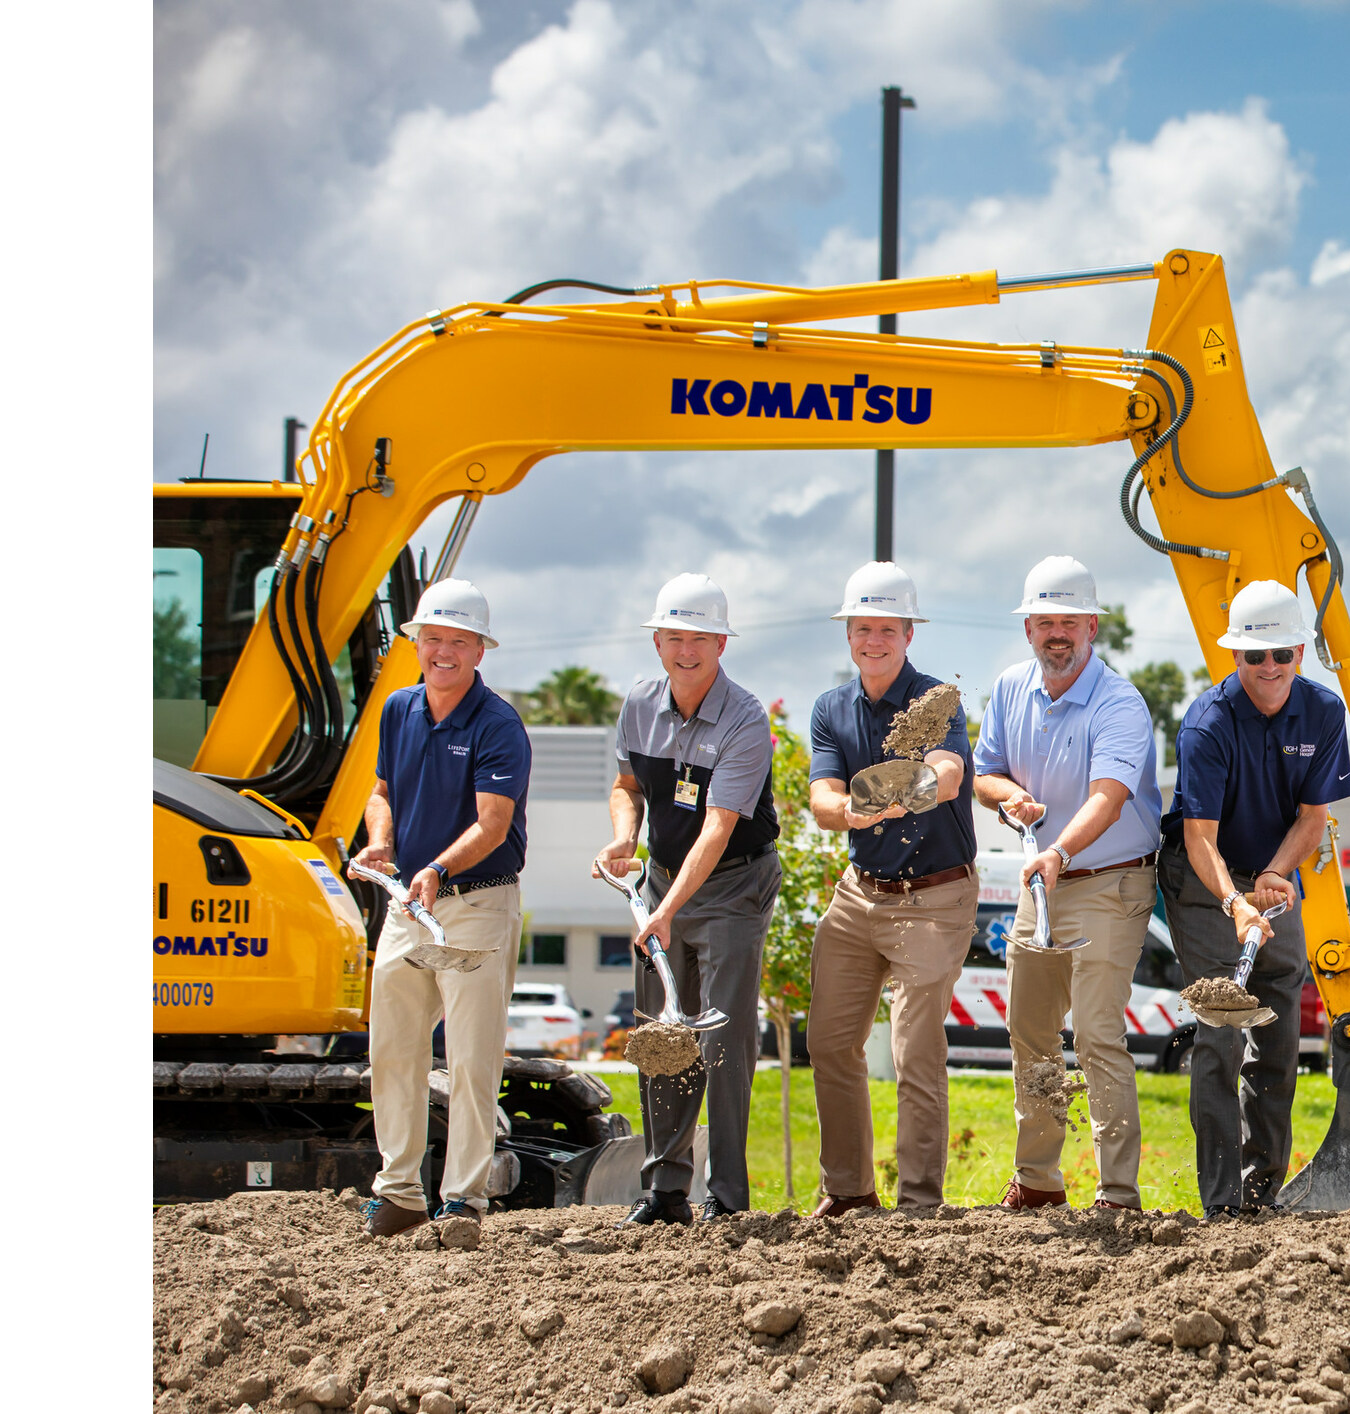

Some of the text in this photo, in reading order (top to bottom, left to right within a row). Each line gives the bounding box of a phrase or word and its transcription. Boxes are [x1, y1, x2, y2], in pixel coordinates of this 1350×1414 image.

[671, 374, 932, 425] KOMATSU
[191, 899, 249, 924] 61211
[153, 931, 268, 957] OMATSU
